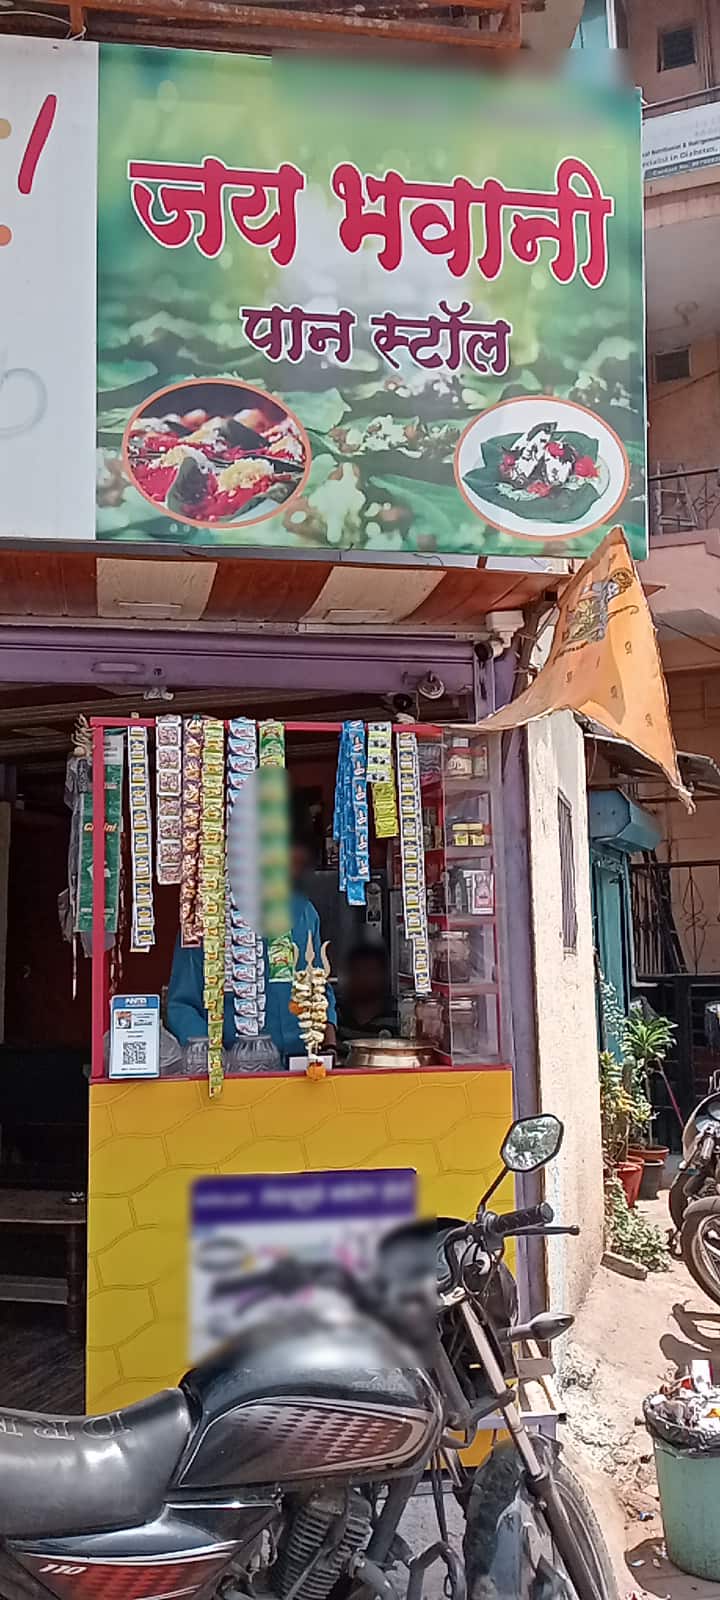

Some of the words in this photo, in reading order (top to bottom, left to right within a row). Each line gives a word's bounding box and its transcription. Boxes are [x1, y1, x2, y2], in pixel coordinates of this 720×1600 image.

[128, 156, 306, 268] जय
[331, 156, 613, 288] भवानी
[240, 303, 356, 364] पान
[369, 299, 512, 375] स्टॉल
[39, 1564, 88, 1575] 110
